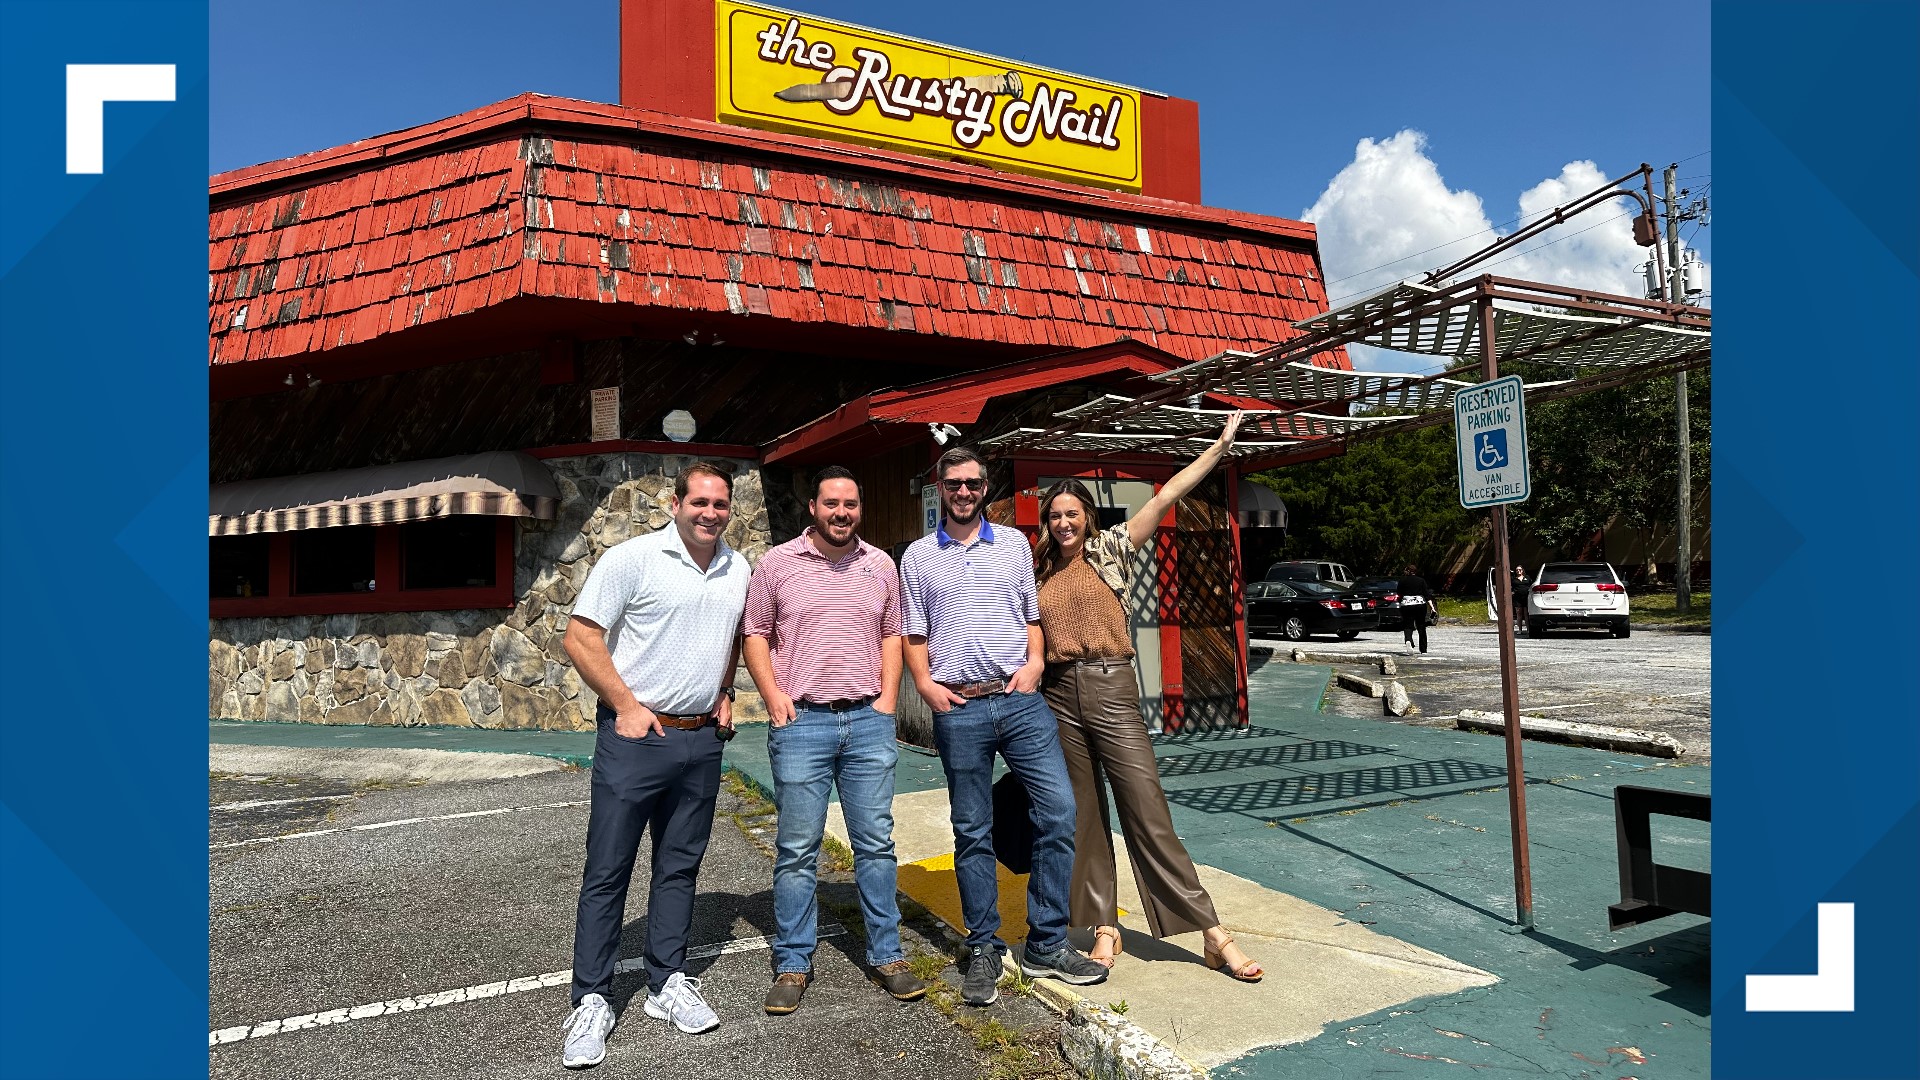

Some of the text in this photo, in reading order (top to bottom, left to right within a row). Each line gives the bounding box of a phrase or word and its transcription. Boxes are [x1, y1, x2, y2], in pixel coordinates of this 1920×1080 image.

[758, 19, 833, 70] the
[825, 49, 1122, 149] Rusty Nail
[1461, 385, 1515, 413] RESERVED
[1467, 407, 1510, 430] PARKING
[1469, 483, 1520, 500] ACCESSIBLE
[1485, 473, 1502, 485] VAN
